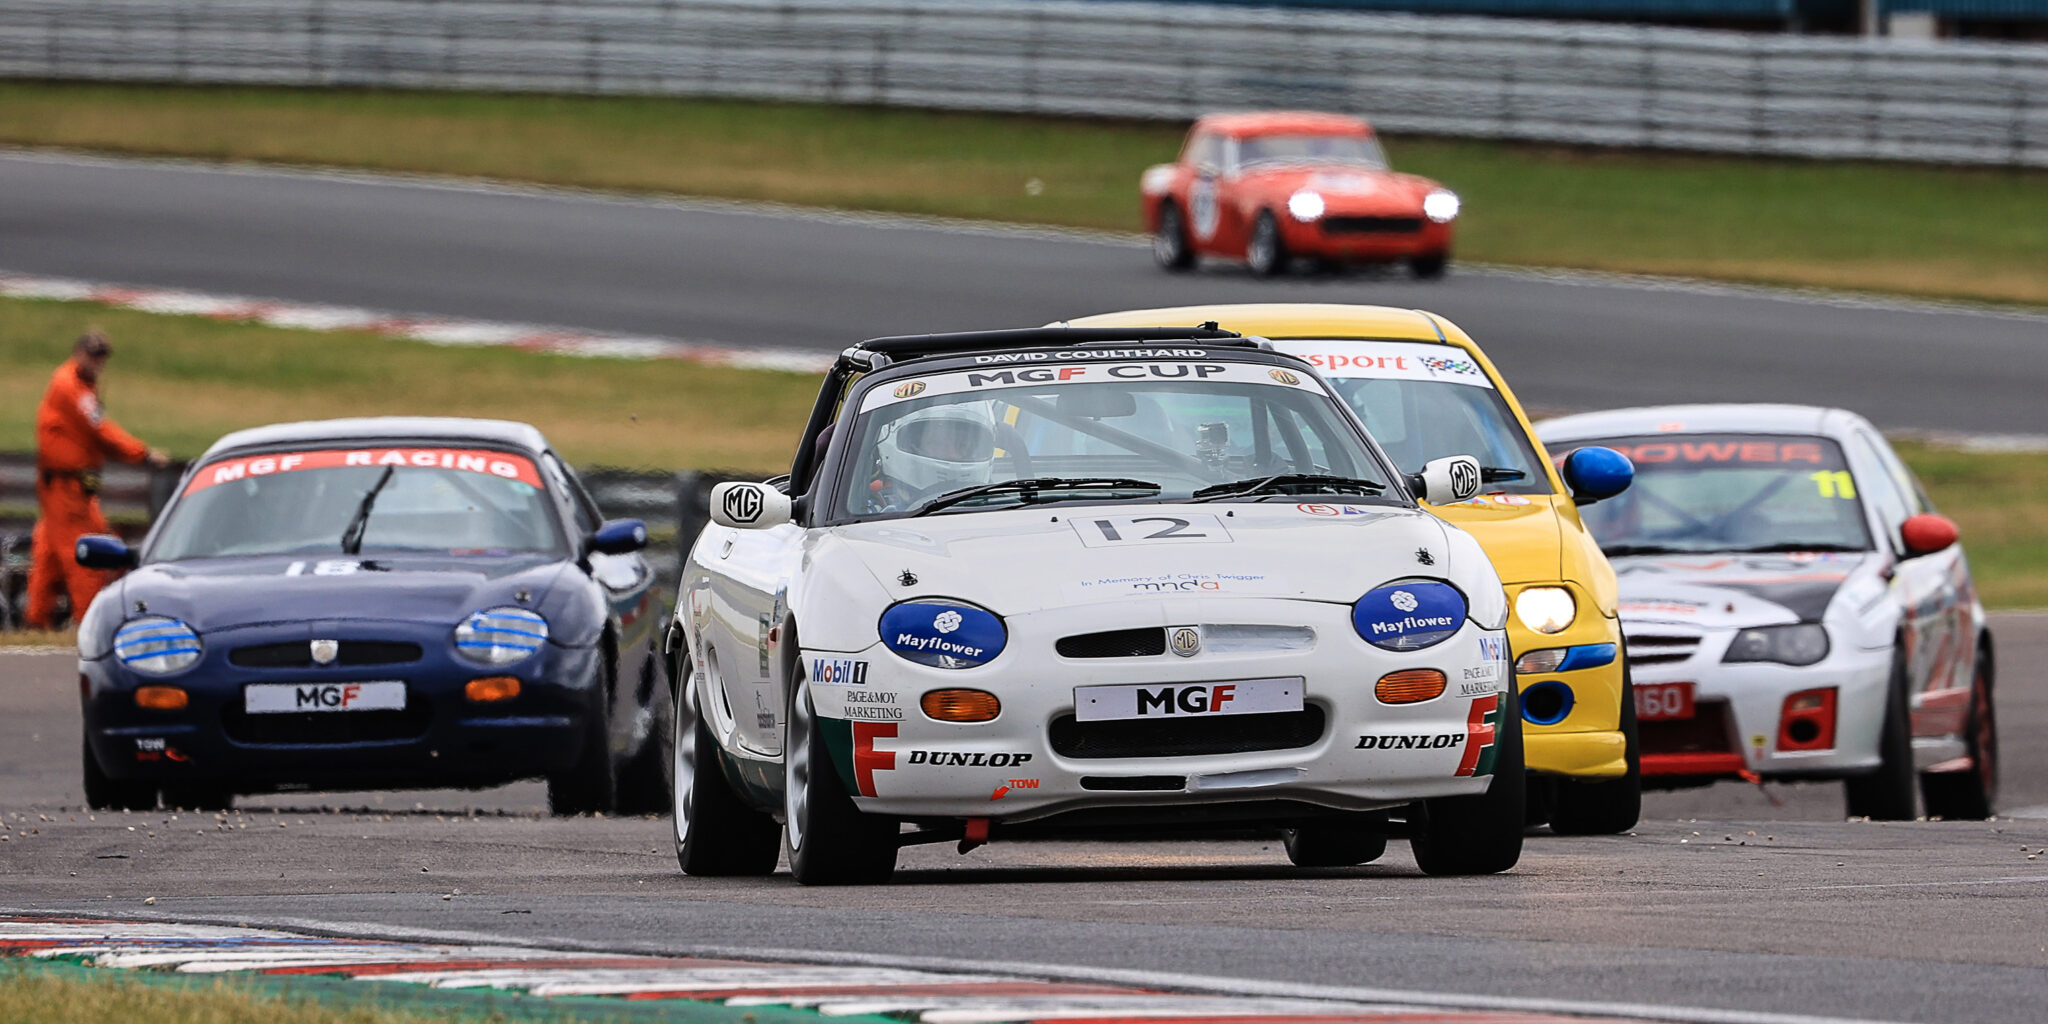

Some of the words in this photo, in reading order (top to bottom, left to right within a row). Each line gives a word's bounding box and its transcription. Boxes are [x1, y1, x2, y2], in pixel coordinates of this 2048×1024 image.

[975, 352, 1048, 364] DAVID
[1055, 349, 1207, 360] COULTHARD
[967, 367, 1086, 387] MGF
[1108, 364, 1226, 379] CUP
[1608, 442, 1823, 464] OWER
[213, 454, 304, 485] MGF
[345, 448, 520, 479] RACING
[1451, 461, 1477, 497] MG
[1810, 469, 1856, 499] 11
[725, 485, 762, 521] MG
[1093, 517, 1207, 541] 12
[1098, 576, 1153, 585] Memory
[1158, 573, 1171, 581] of
[1133, 579, 1220, 592] mnda
[1371, 614, 1453, 635] Mayflower
[896, 632, 983, 658] Mayflower
[1174, 630, 1199, 652] MG
[812, 658, 851, 684] Mobil
[854, 661, 867, 684] 1
[296, 685, 362, 709] MGF
[1136, 684, 1236, 716] MGF
[844, 706, 903, 719] MARKETING
[1354, 733, 1465, 750] DUNLOP
[1453, 694, 1499, 777] F
[853, 721, 899, 798] F
[908, 750, 1033, 768] DUNLOP
[1008, 778, 1041, 789] TOW
